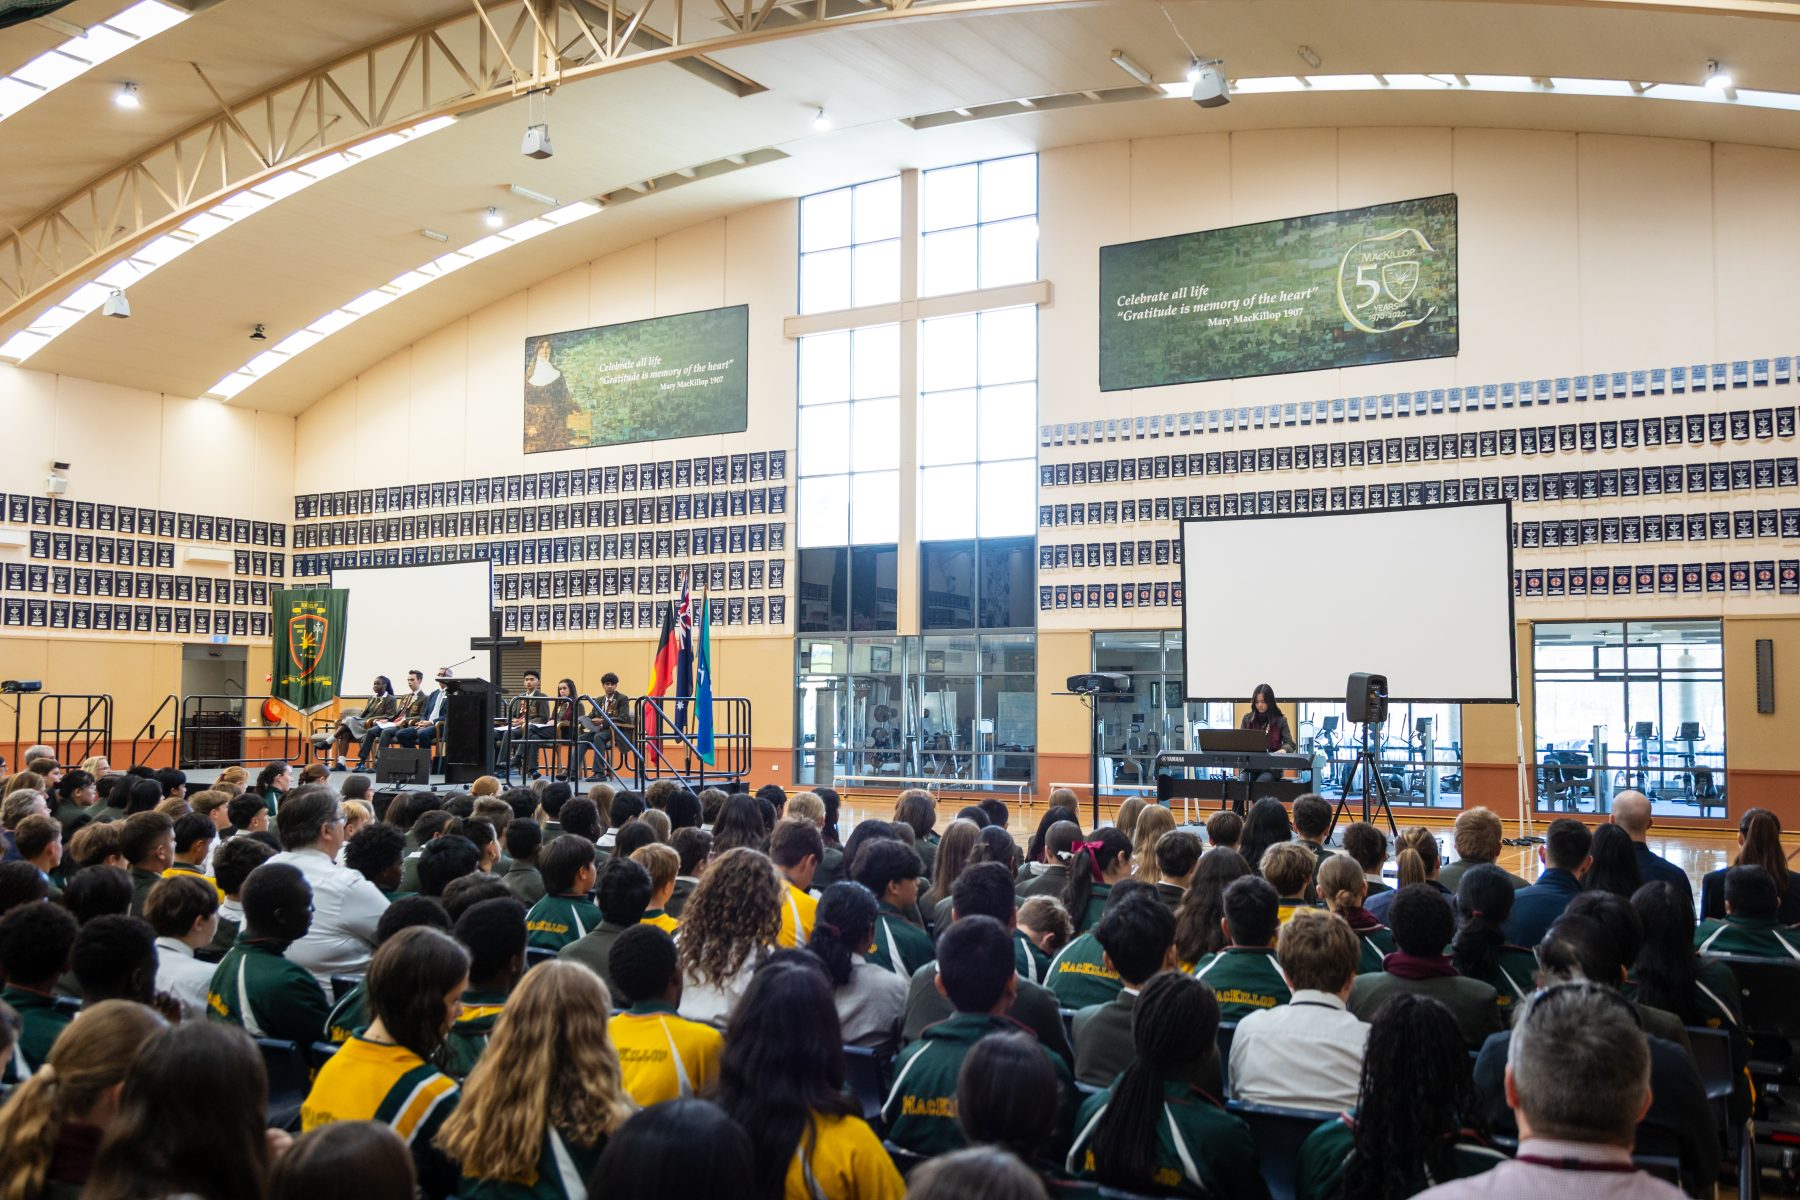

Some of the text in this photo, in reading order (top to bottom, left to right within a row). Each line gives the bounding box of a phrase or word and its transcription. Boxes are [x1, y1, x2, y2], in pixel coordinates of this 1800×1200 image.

[1116, 284, 1209, 307] Celebrate all life
[1180, 303, 1191, 315] is
[1193, 299, 1240, 313] memory
[1242, 293, 1257, 309] of
[1258, 292, 1277, 304] the
[1207, 307, 1304, 327] Mary MacKillop 1907
[1373, 303, 1399, 312] YEARS
[599, 354, 662, 373] Celebrate all life
[641, 370, 649, 380] is
[650, 368, 682, 378] memory
[683, 363, 693, 377] of
[693, 363, 706, 373] the
[660, 375, 724, 391] Mary MacKillop 1907
